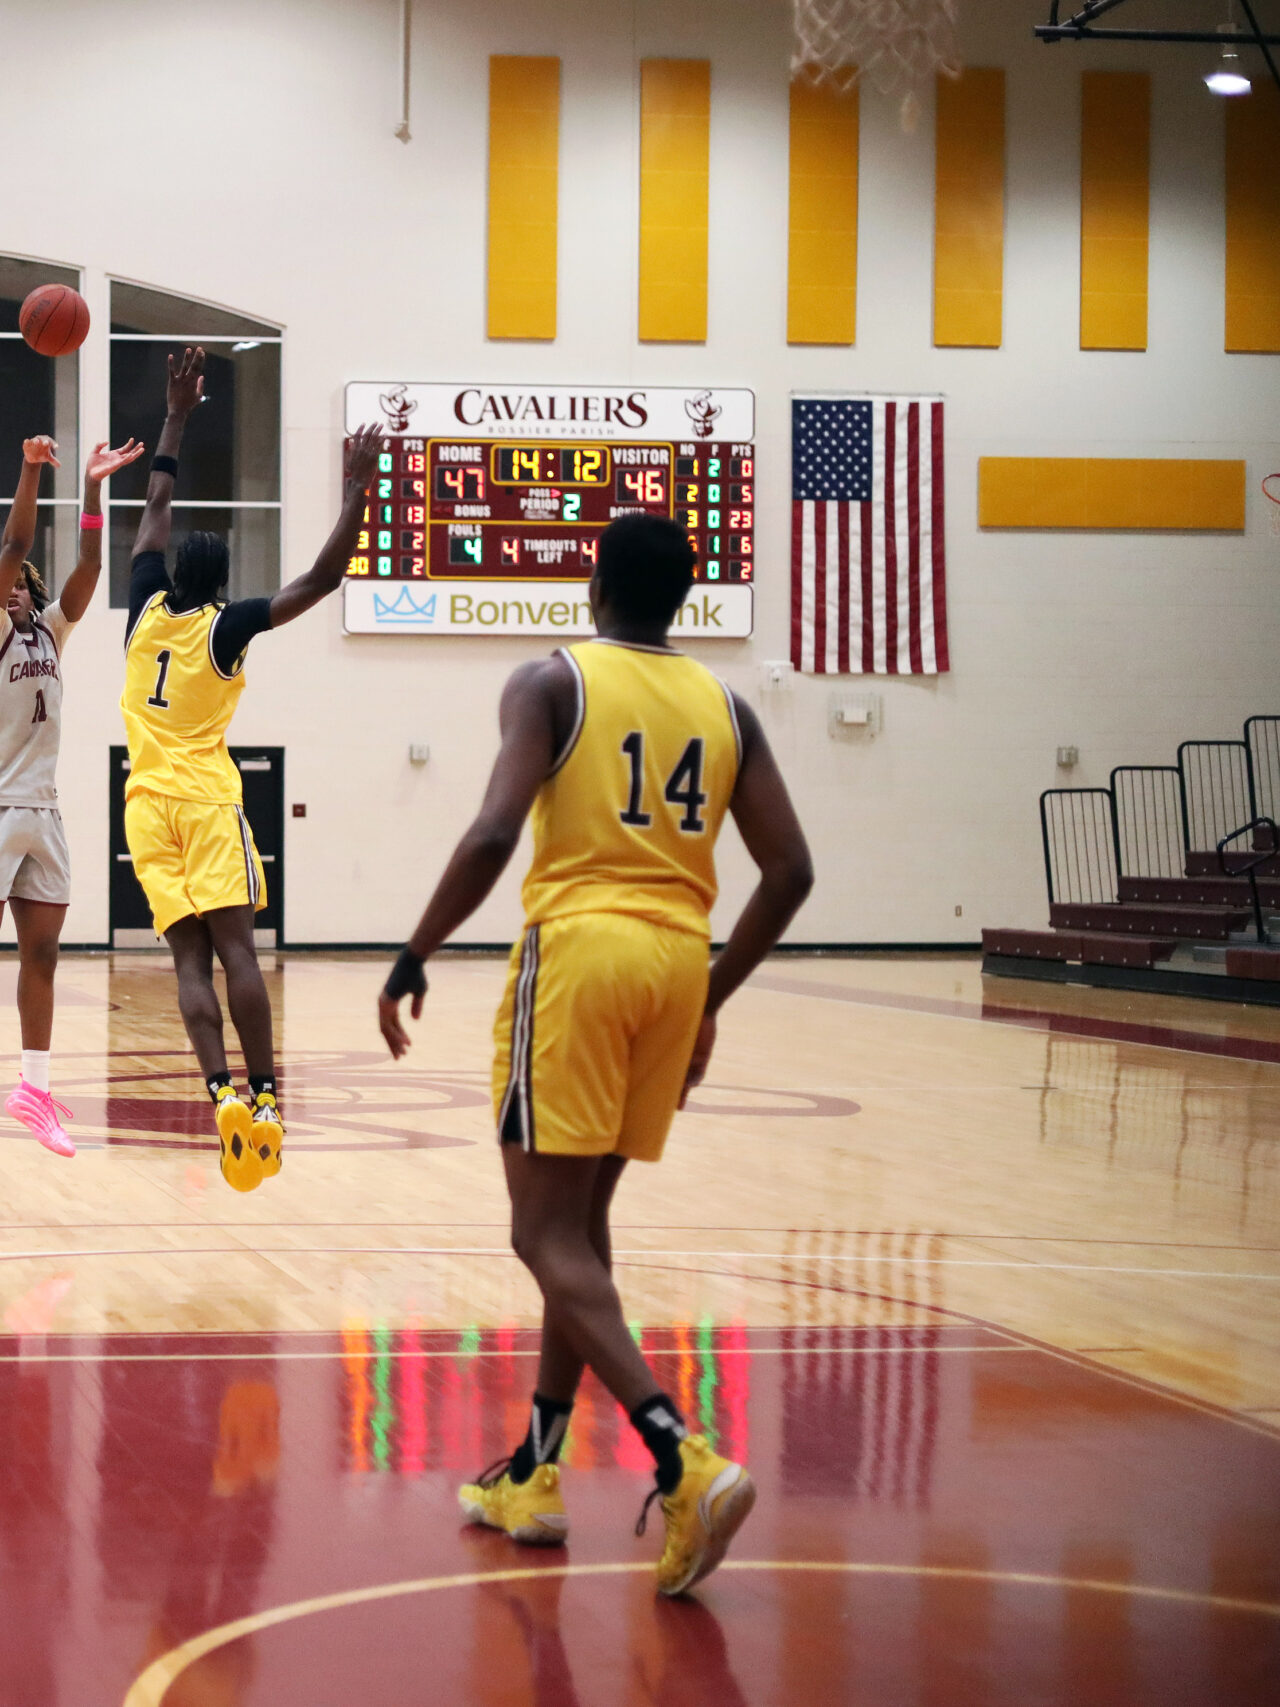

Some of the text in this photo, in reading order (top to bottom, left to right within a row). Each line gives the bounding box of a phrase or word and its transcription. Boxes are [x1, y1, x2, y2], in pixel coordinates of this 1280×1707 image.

[454, 389, 648, 428] CAVALIERS
[489, 427, 615, 436] BOSSIER PARISH
[403, 439, 424, 451] PTS
[439, 446, 482, 462] HOME
[680, 444, 752, 457] NO F PTS
[379, 453, 425, 472] 0 13
[612, 449, 669, 465] VISITOR
[693, 458, 753, 478] 1 2 0
[378, 479, 424, 498] 2 9
[444, 468, 484, 499] 47
[625, 471, 664, 502] 46
[687, 484, 753, 503] 2 0 5
[454, 505, 491, 517] BONUS
[520, 498, 560, 511] PERIOD
[563, 493, 581, 521] 2
[384, 505, 392, 524] 1
[407, 506, 425, 524] 13
[687, 509, 753, 529] 3 0 23
[448, 524, 482, 535] FOULS
[378, 530, 392, 550] 0
[412, 532, 424, 549] 2
[524, 540, 577, 552] TIMEOUTS
[713, 535, 720, 554] 1
[741, 535, 752, 554] 6
[464, 537, 482, 564] 4
[502, 538, 519, 564] 4
[537, 552, 563, 563] LEFT
[581, 539, 597, 565] 4
[378, 556, 392, 576] 0
[412, 557, 424, 575] 2
[707, 560, 720, 580] 0
[740, 561, 752, 580] 2
[450, 594, 595, 626] Bonven
[147, 649, 171, 709] 1
[619, 731, 708, 833] 14
